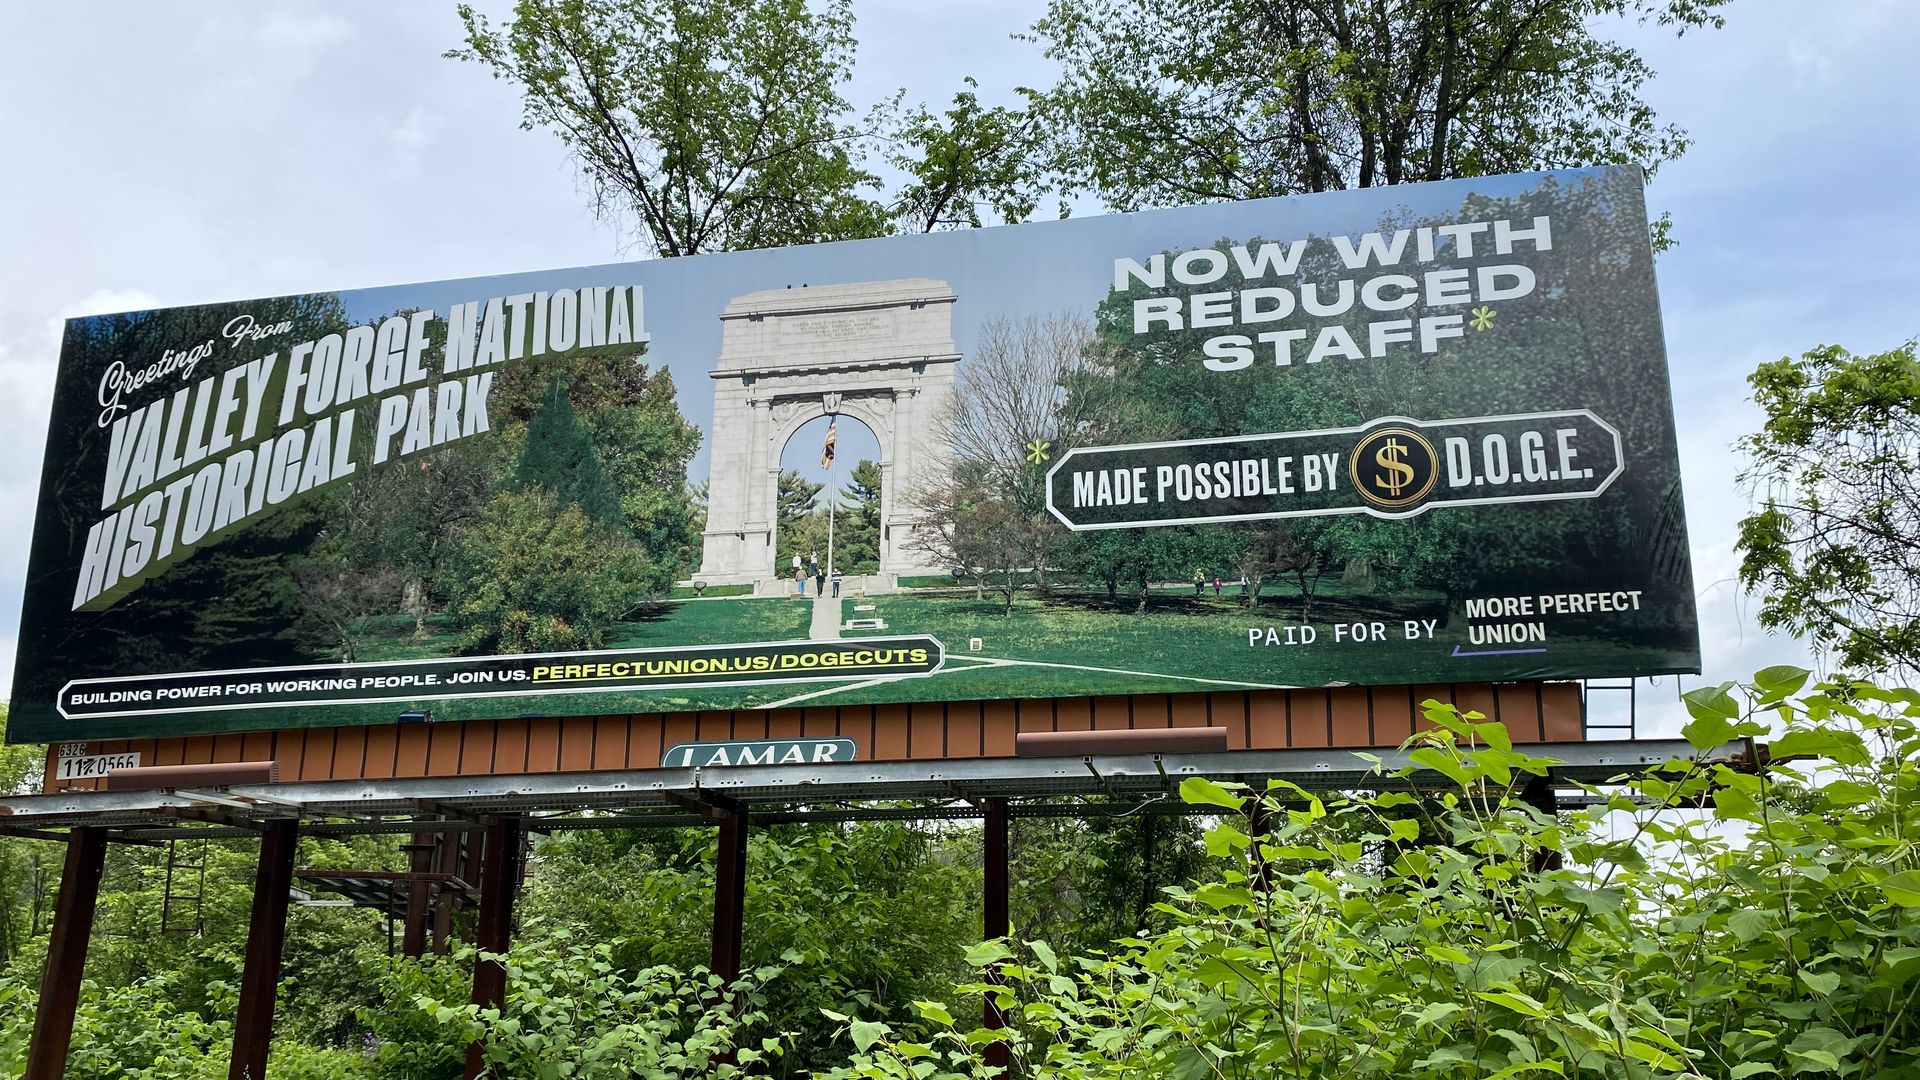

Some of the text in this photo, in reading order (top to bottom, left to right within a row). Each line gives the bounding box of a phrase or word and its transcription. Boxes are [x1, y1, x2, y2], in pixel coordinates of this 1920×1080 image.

[1114, 216, 1552, 291] NOW WITH
[1133, 264, 1536, 333] REDUCED
[98, 315, 293, 428] Greetings From
[102, 285, 651, 511] VALLEY FORGE NATIONAL
[72, 372, 495, 611] HISTORICAL PARK
[1073, 467, 1148, 508] MADE
[1156, 456, 1294, 502] POSSIBLE
[1304, 452, 1339, 492] BY
[1445, 428, 1594, 489] D.O.G.E.
[1248, 619, 1438, 647] PAID FOR BY
[1465, 590, 1642, 618] MORE PERFECT
[1468, 622, 1546, 645] UNION
[70, 648, 928, 705] BUILDING POWER FOR WORKING PEOPLE. JOIN US. PERFECTUNION.US/DOGECUTS
[60, 744, 86, 756] 6326
